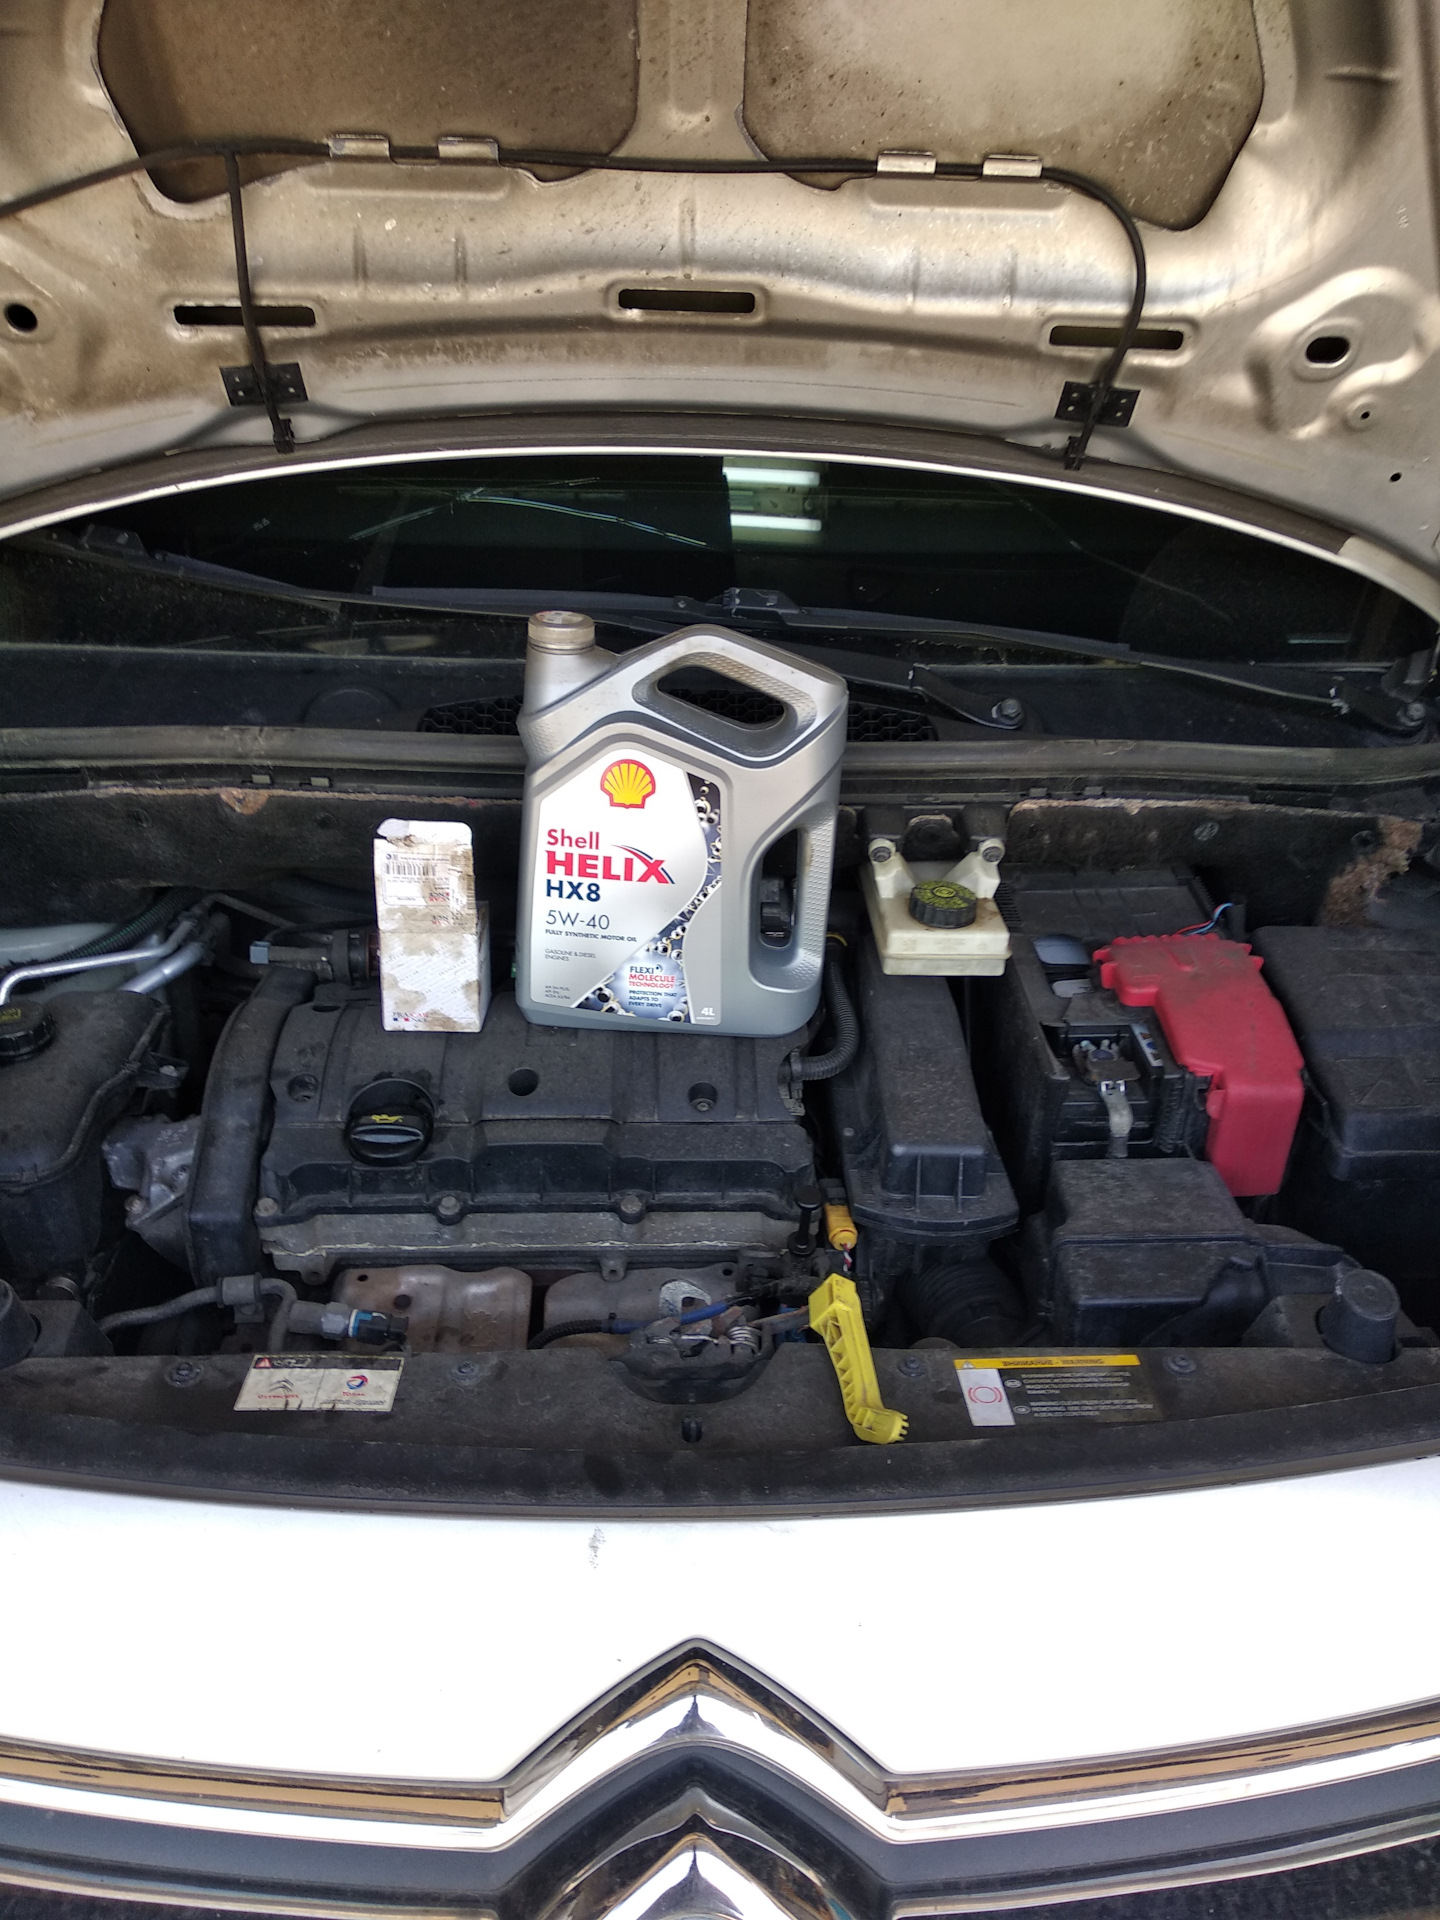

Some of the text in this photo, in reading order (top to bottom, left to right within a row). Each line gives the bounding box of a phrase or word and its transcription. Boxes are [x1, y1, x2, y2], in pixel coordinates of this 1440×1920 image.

[546, 828, 600, 850] Shell
[545, 847, 672, 885] HELIX
[546, 878, 602, 903] HX8
[545, 909, 611, 931] 5W-40
[545, 928, 563, 936] FULLY
[564, 930, 600, 941] SYNTHETIC
[600, 934, 626, 943] MOTOR
[629, 965, 655, 975] FLEXI
[628, 973, 676, 983] MOLECULE
[628, 981, 675, 989] TECHNOLOGY
[700, 1006, 717, 1017] 4L
